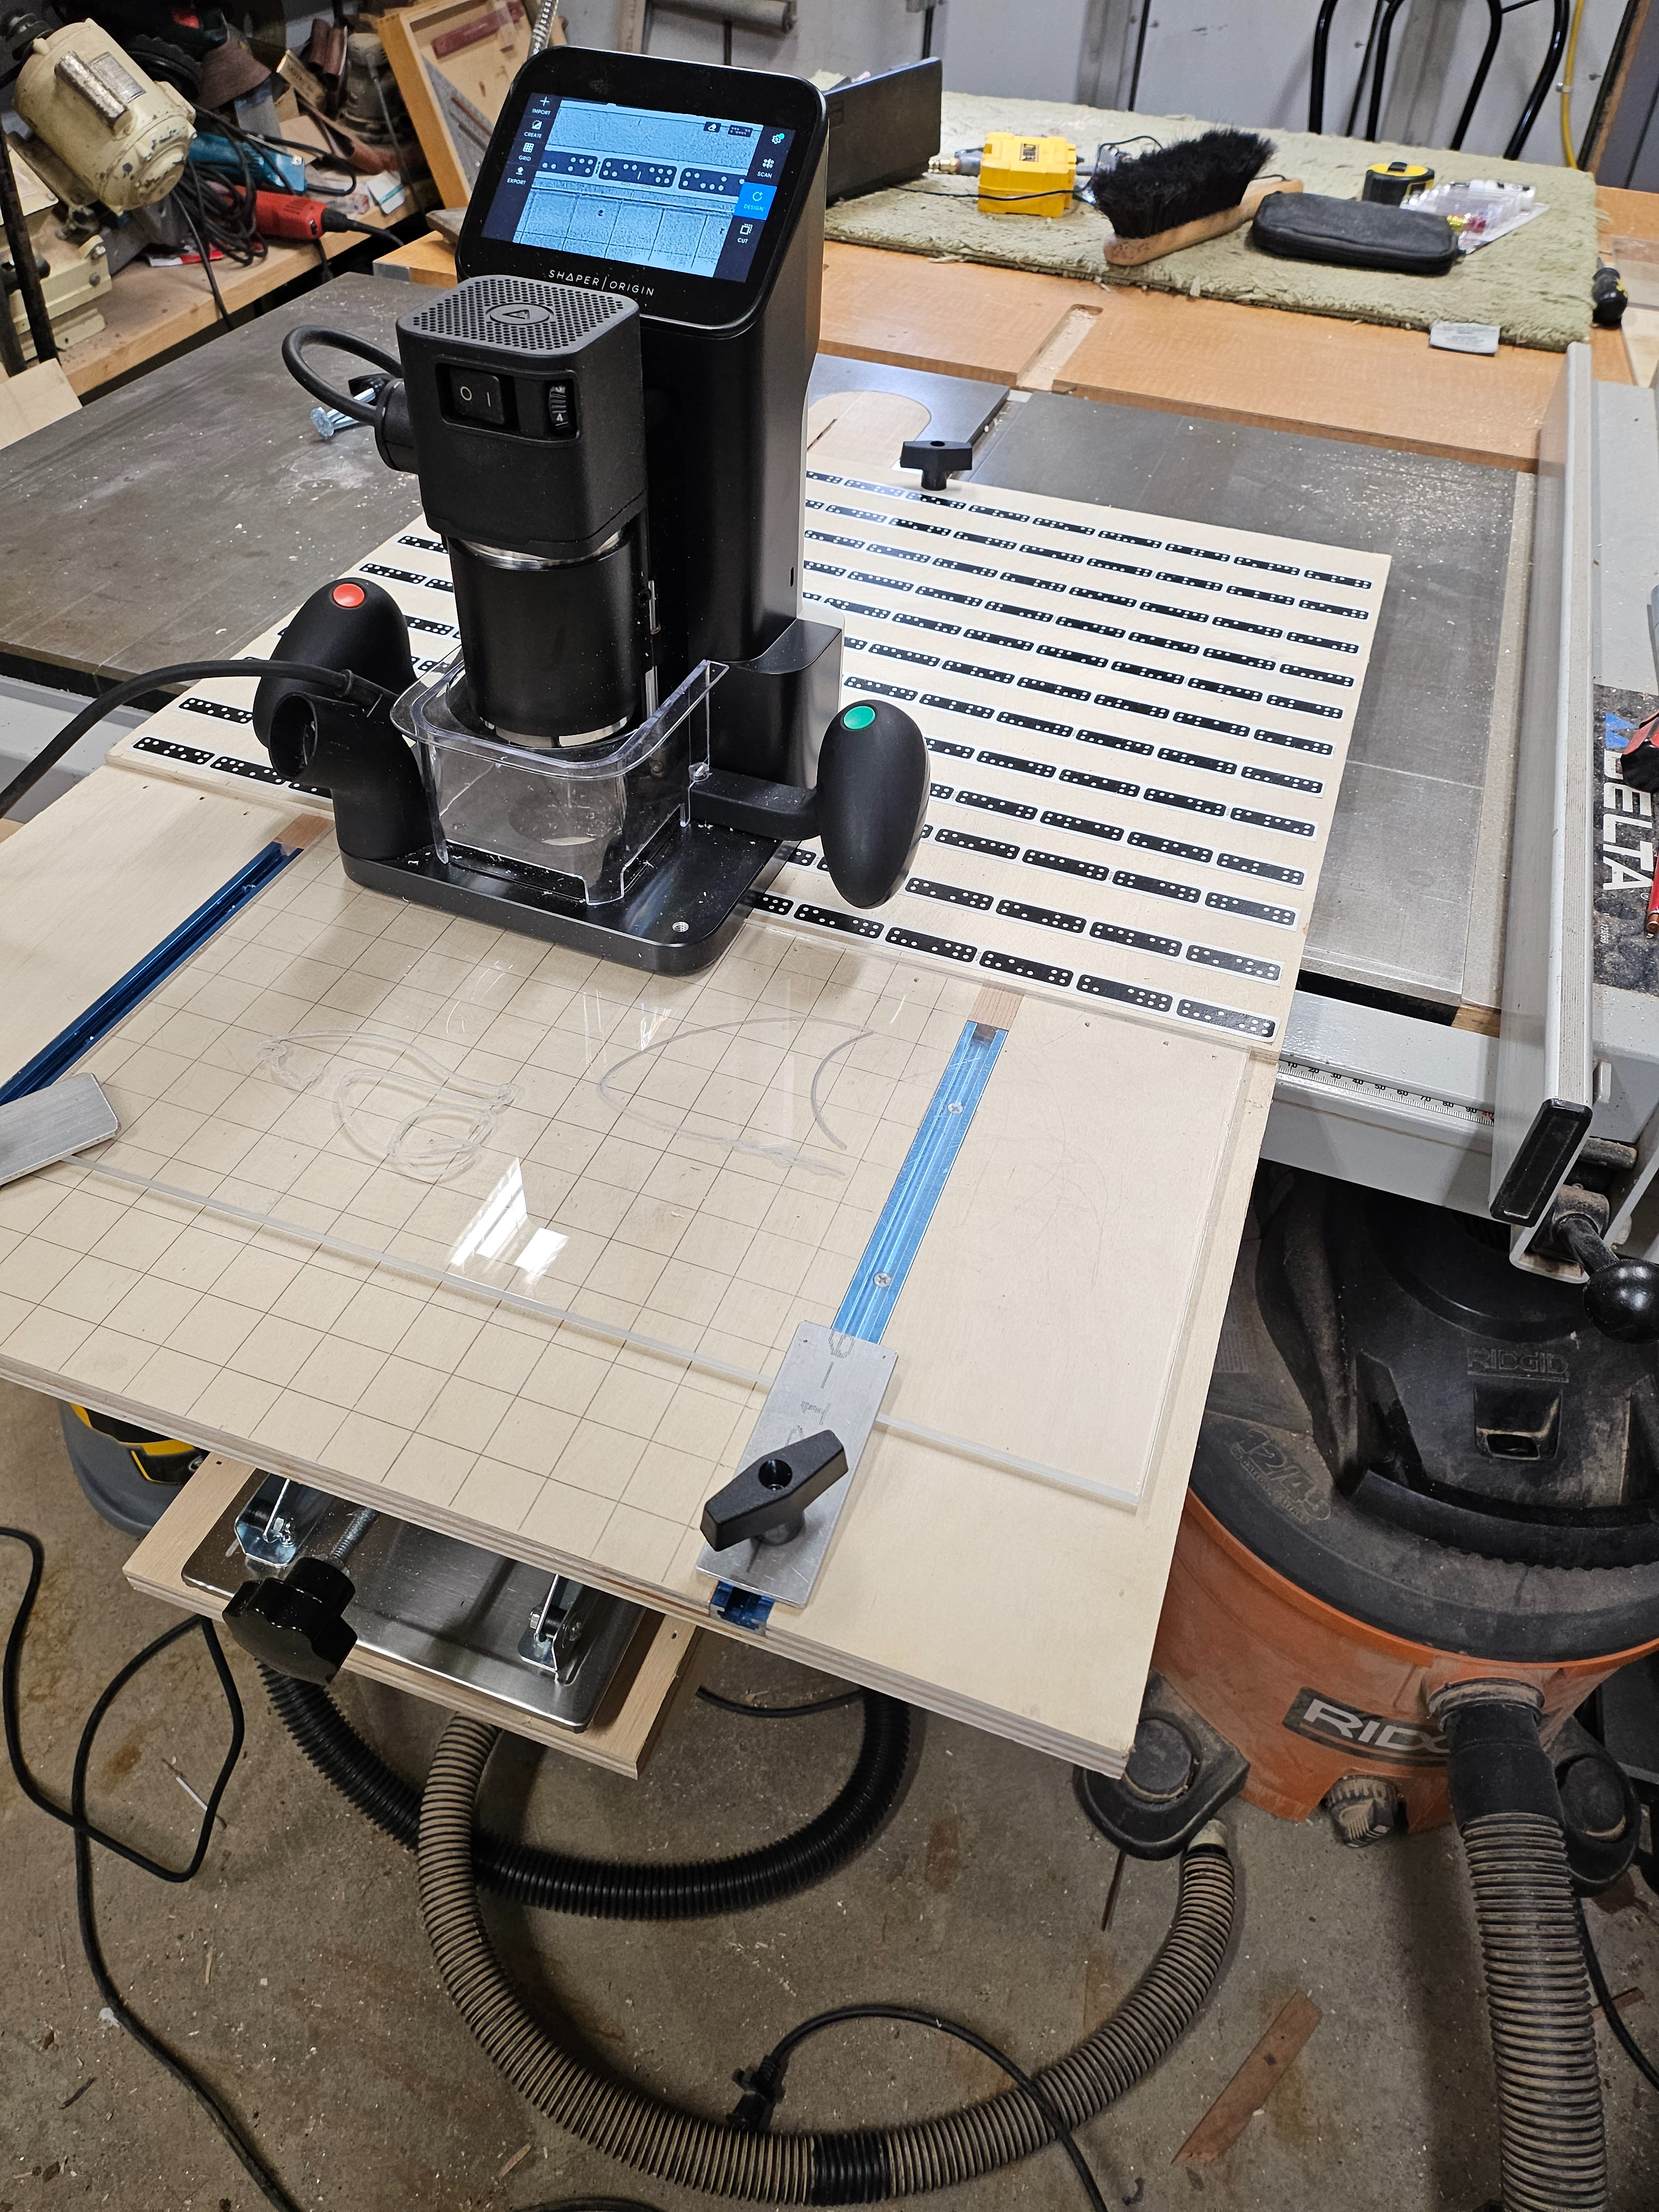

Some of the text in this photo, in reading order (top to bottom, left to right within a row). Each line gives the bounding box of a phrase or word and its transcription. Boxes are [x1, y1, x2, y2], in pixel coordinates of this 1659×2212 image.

[743, 204, 764, 212] DESIGN
[609, 281, 654, 296] ORIGIN
[556, 413, 564, 422] 4
[1467, 1347, 1569, 1374] RIDGID
